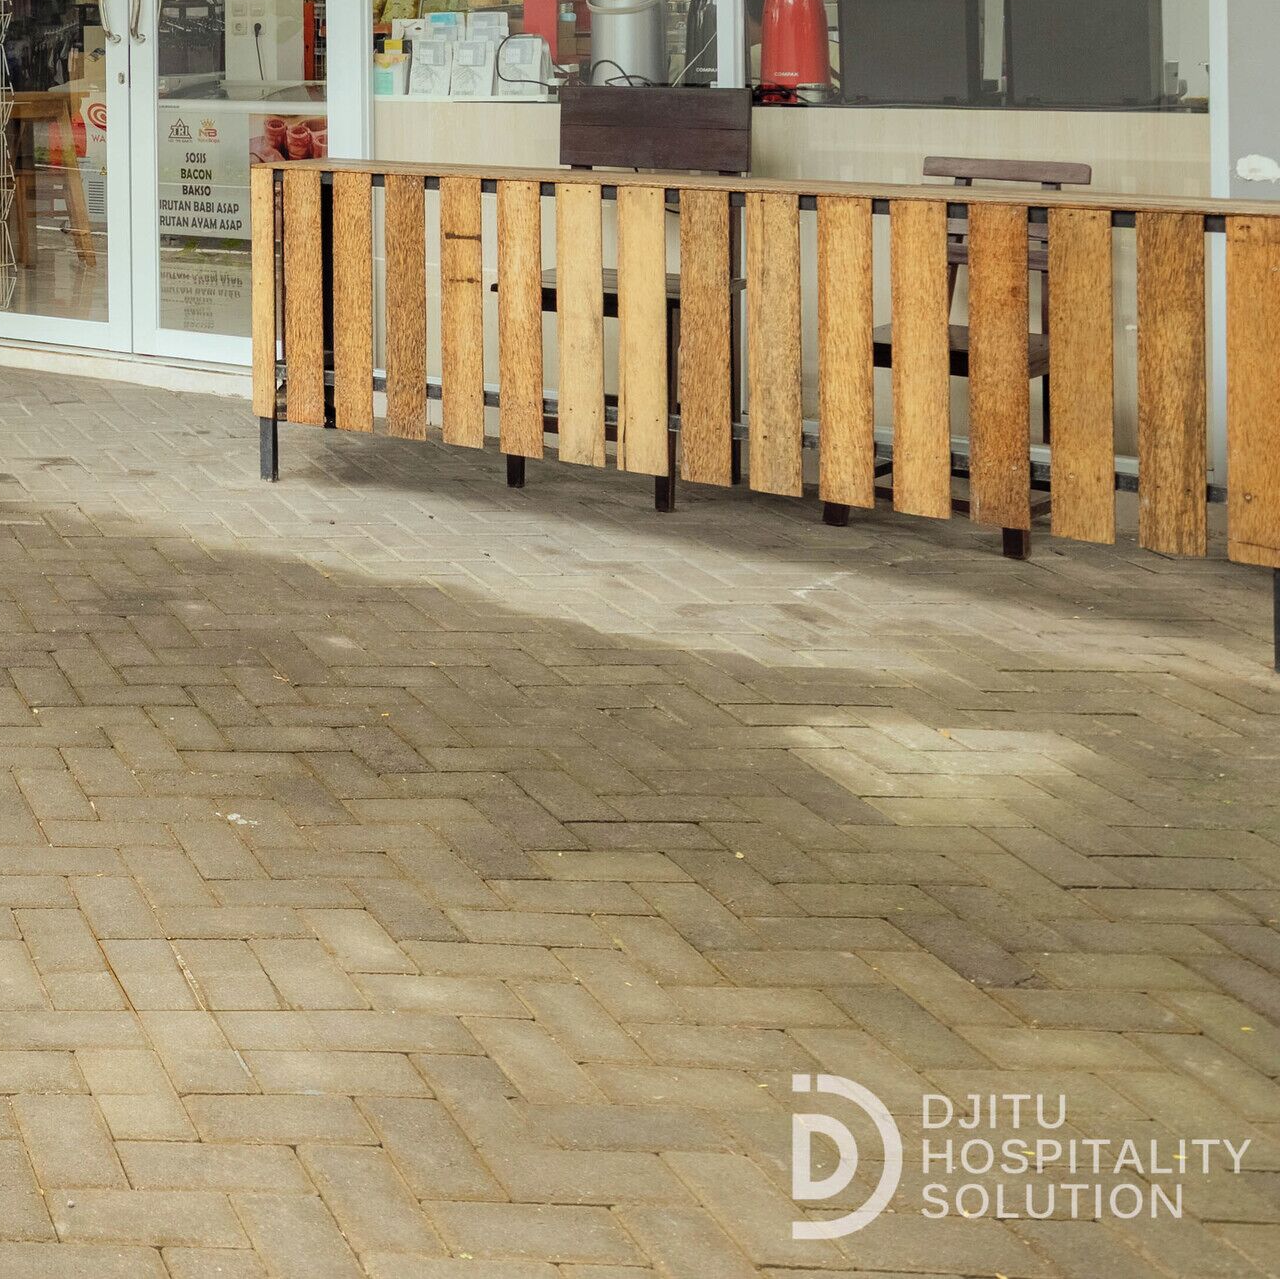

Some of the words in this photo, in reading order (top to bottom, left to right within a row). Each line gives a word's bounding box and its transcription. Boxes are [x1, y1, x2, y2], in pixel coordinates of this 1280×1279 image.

[185, 152, 206, 163] SOSIS
[180, 168, 212, 180] BACON
[182, 185, 211, 197] BAKSO
[193, 202, 215, 213] BABI
[216, 202, 239, 214] ASAP
[191, 217, 217, 229] AYAM
[220, 219, 242, 231] ASAP
